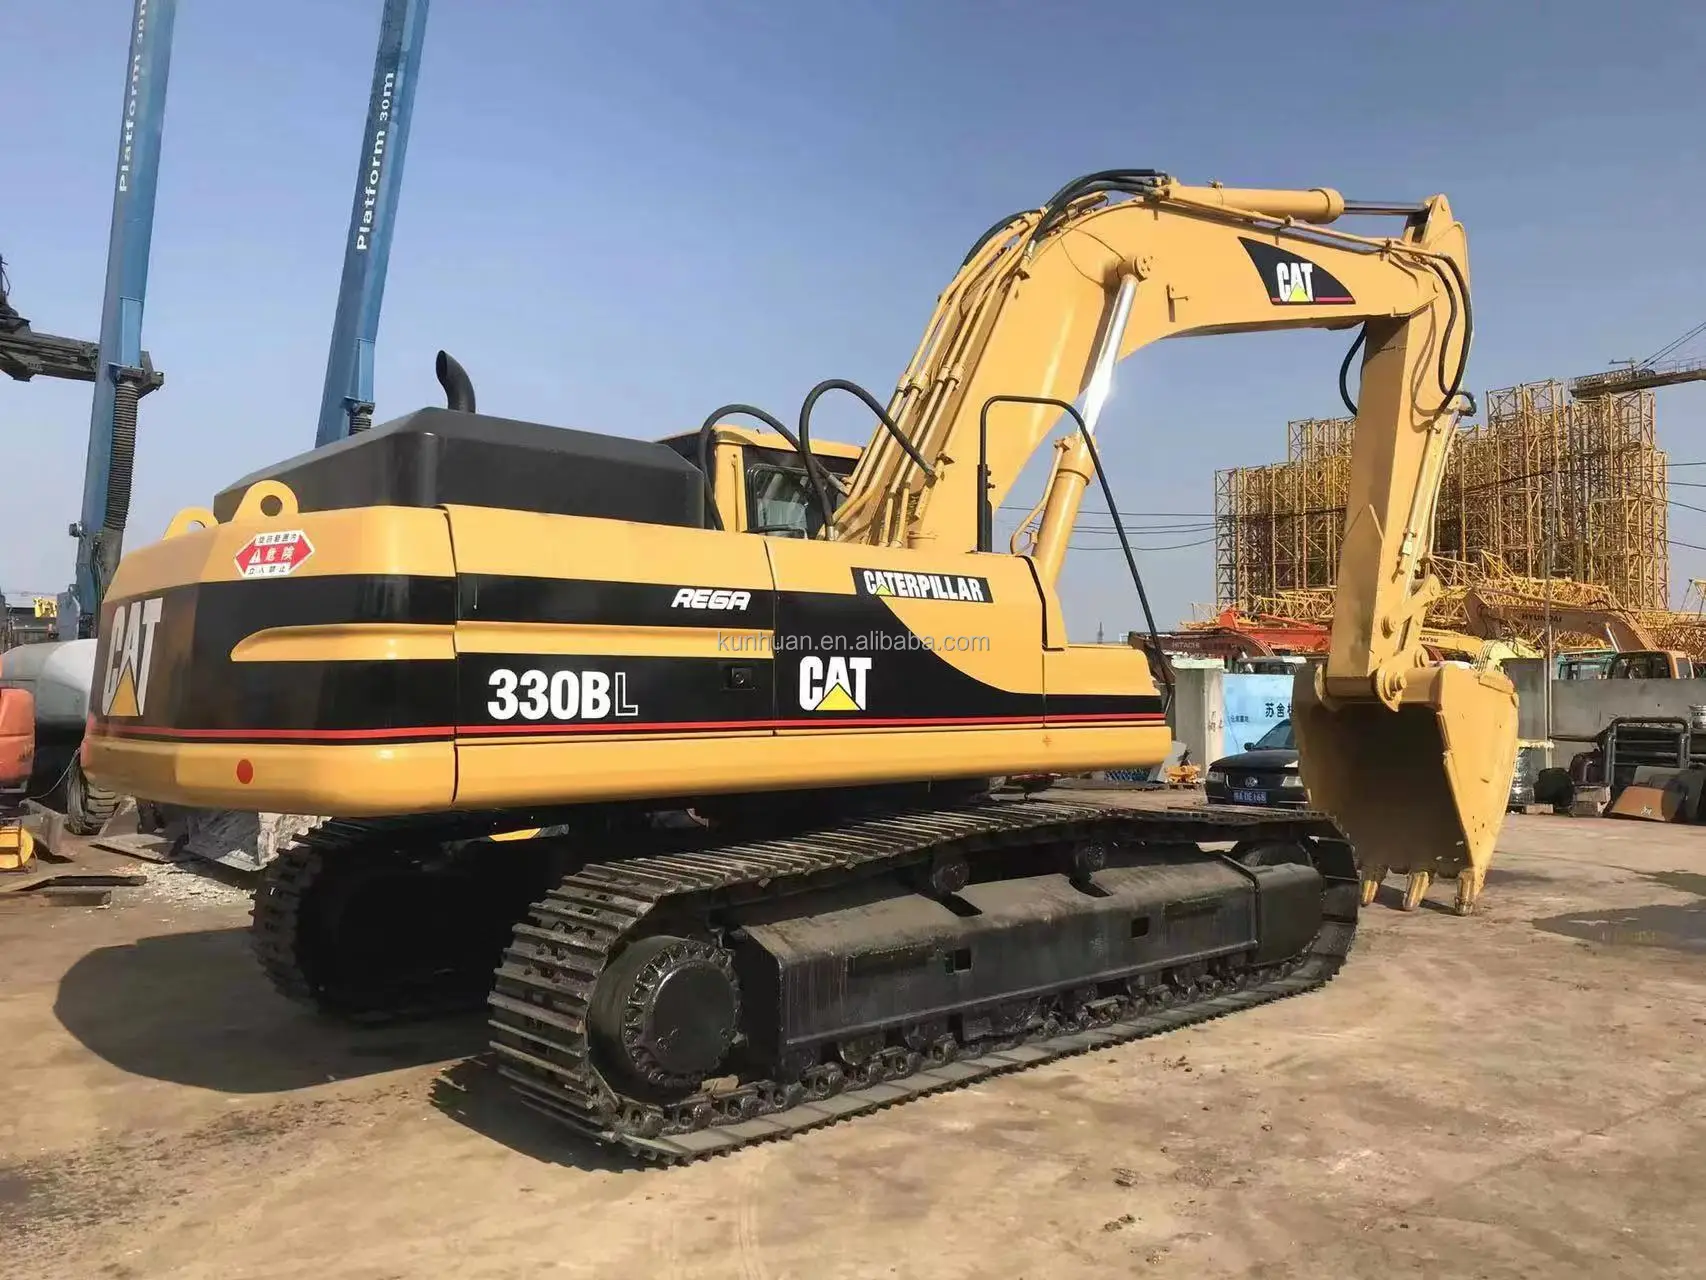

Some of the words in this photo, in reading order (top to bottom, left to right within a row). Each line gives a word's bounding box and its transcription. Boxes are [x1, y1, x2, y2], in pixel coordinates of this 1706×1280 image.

[119, 54, 141, 192] Platform
[356, 130, 386, 251] Platform
[379, 72, 394, 121] 30m
[1276, 262, 1314, 302] CAT
[671, 588, 751, 611] REGA
[863, 570, 984, 602] CATERPILLAR
[102, 597, 164, 717] CAT
[799, 655, 873, 711] CAT
